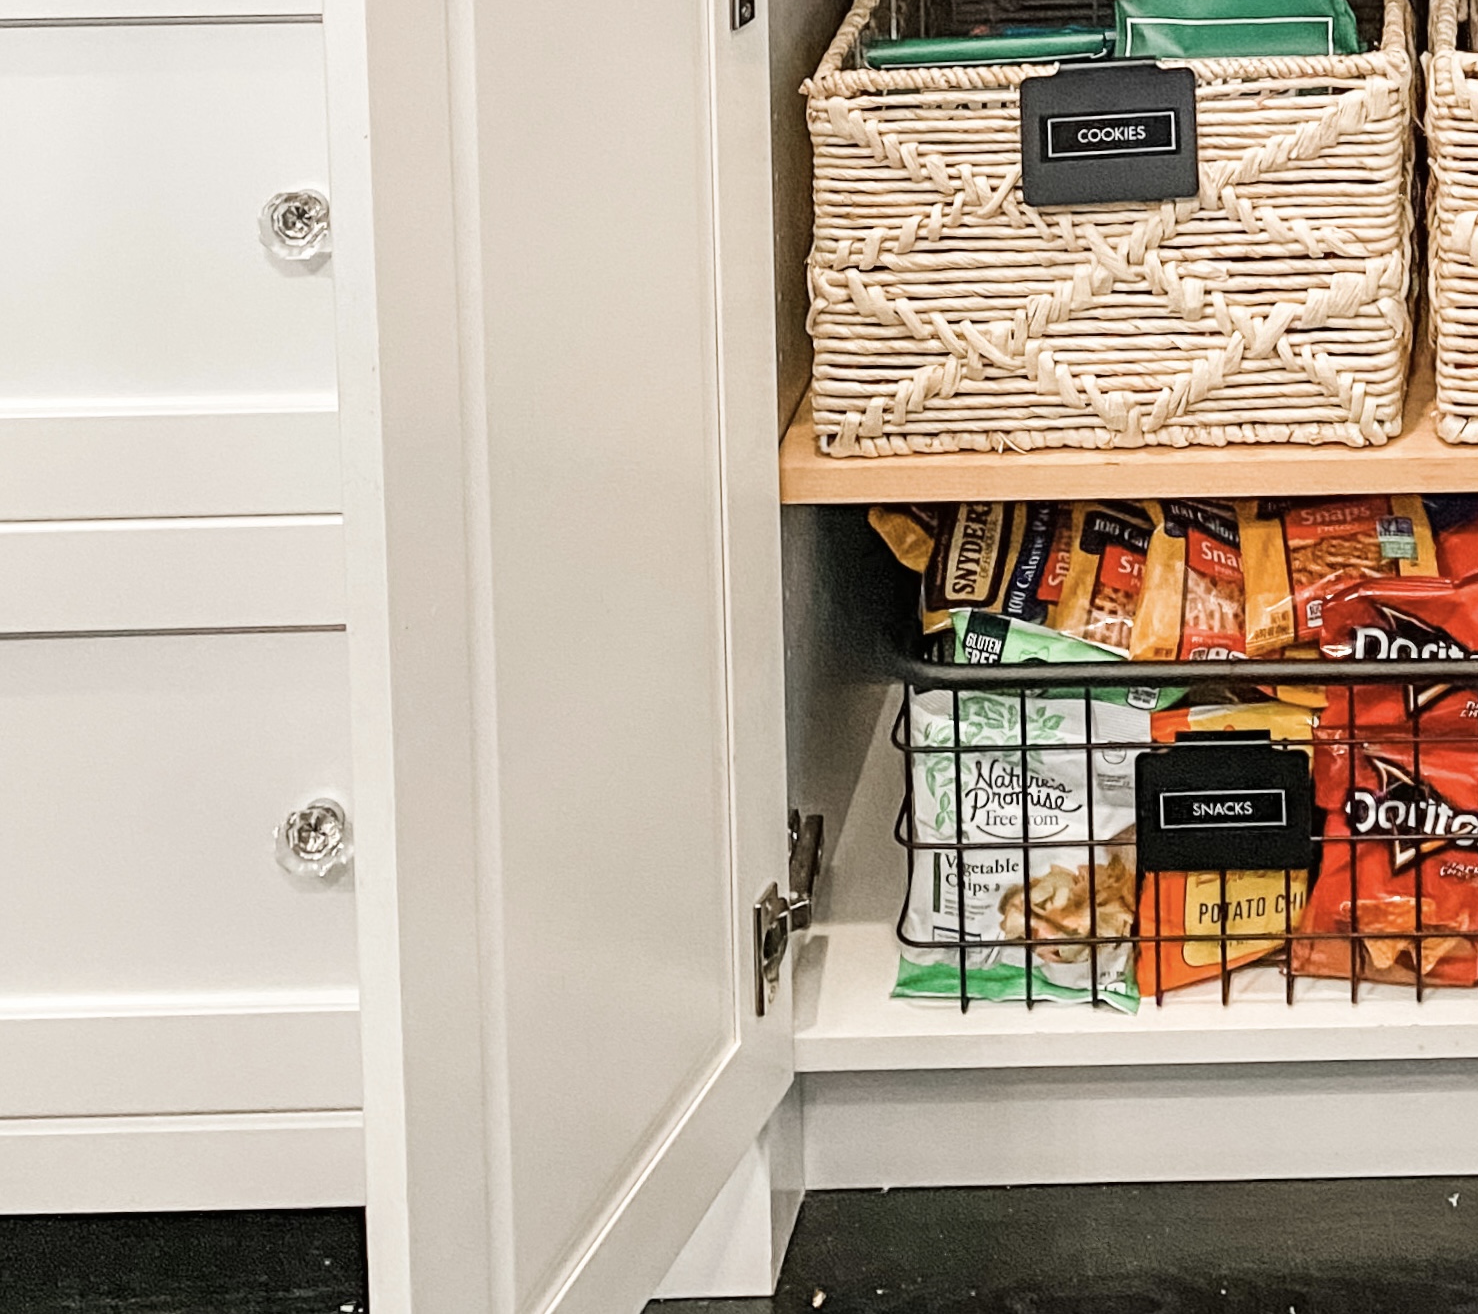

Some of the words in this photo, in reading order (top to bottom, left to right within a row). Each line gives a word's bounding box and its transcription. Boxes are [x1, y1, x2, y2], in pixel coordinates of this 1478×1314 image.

[1076, 124, 1147, 145] COOKIES
[1300, 503, 1372, 526] Snaps
[1093, 518, 1120, 536] 100
[1016, 536, 1044, 590] Calorie
[1007, 589, 1026, 615] 100
[965, 632, 1003, 655] GLUTEN
[964, 787, 1084, 822] Promise
[1192, 801, 1254, 817] SNACKS
[985, 809, 1018, 826] Free
[1026, 810, 1060, 827] rom
[943, 851, 1021, 876] Vgetable
[944, 871, 990, 896] Cips
